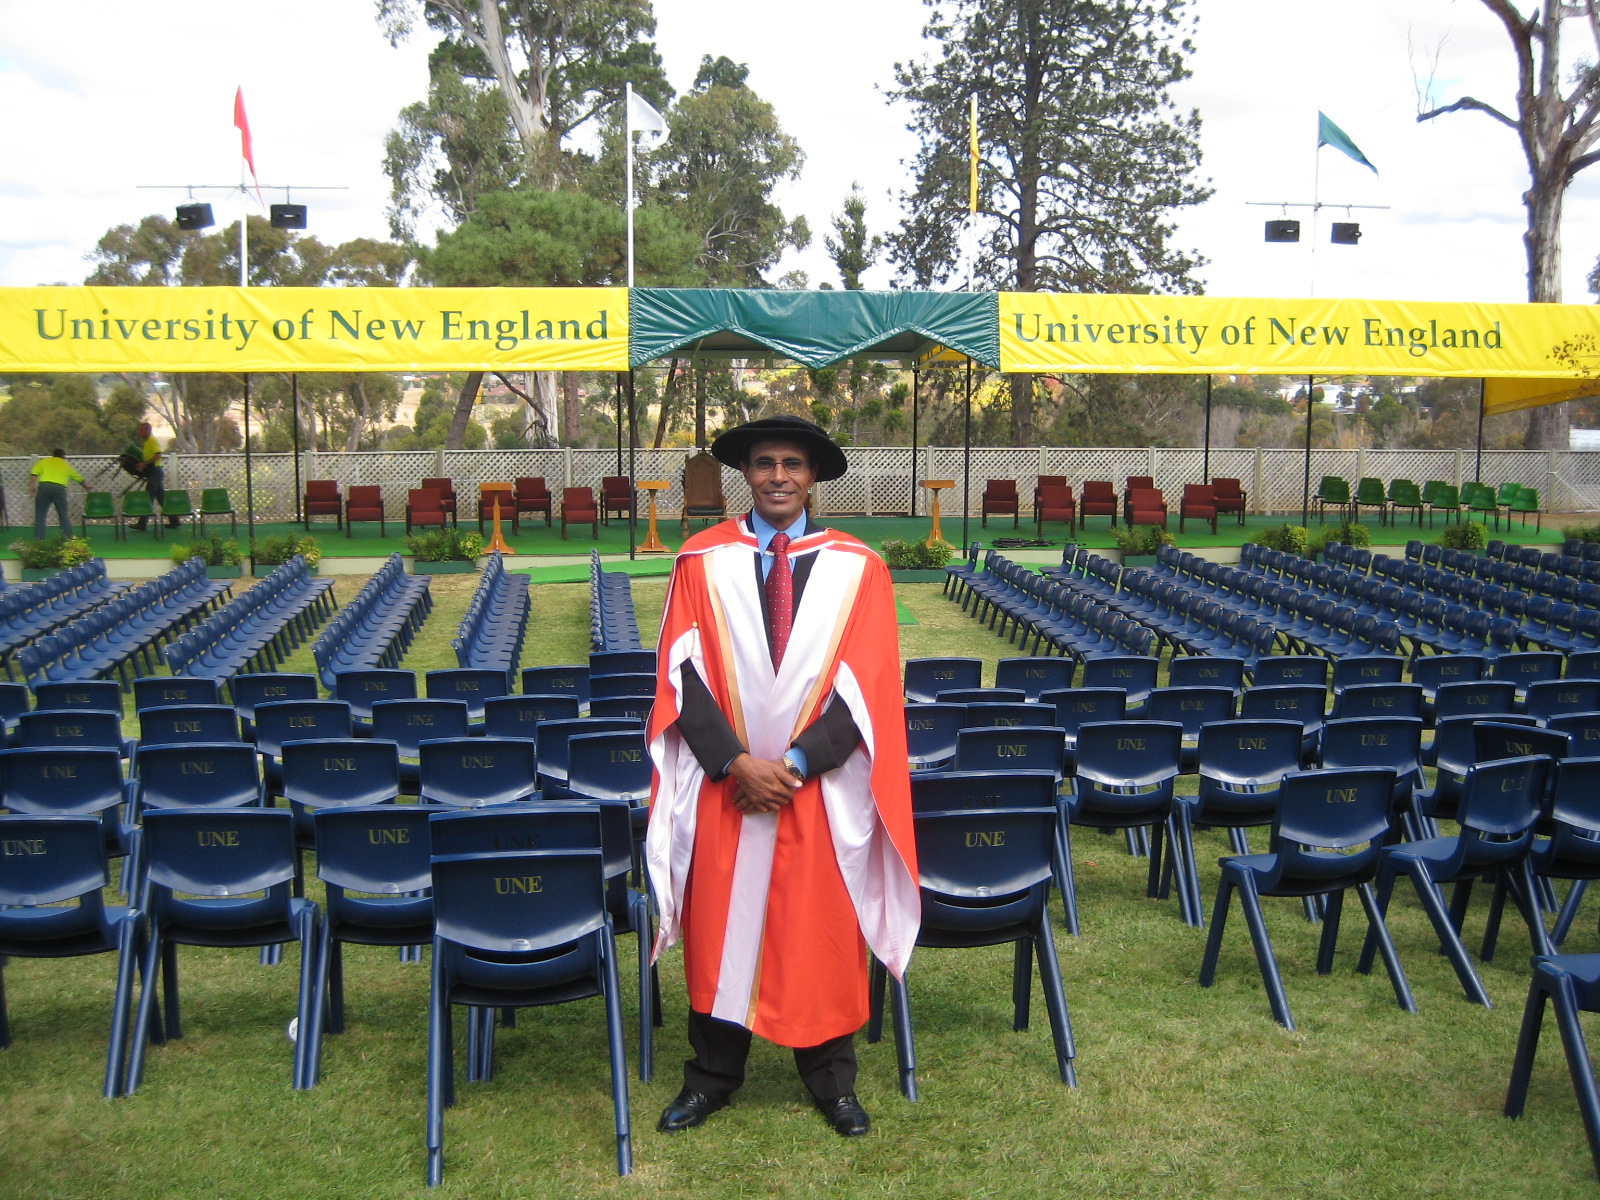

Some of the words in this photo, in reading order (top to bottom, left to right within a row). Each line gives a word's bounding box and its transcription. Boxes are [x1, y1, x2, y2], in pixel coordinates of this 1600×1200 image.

[34, 308, 259, 351] University
[272, 308, 314, 341] of
[329, 310, 425, 341] New
[440, 309, 608, 350] England
[1014, 312, 1209, 355] University
[1221, 315, 1256, 346] of
[1267, 317, 1350, 346] New
[1363, 318, 1503, 357] England
[1113, 669, 1132, 677] UNE
[1199, 669, 1219, 677] UNE
[1282, 668, 1302, 677] UNE
[1361, 668, 1380, 677] UNE
[1441, 666, 1459, 675] UNE
[1521, 663, 1539, 672] UNE
[933, 671, 954, 679] UNE
[1026, 670, 1046, 678] UNE
[455, 682, 479, 691] UNE
[552, 678, 574, 688] UNE
[164, 690, 187, 700] UNE
[264, 687, 286, 696] UNE
[1372, 697, 1394, 707] UNE
[1467, 695, 1488, 705] UNE
[1557, 693, 1578, 703] UNE
[1072, 702, 1095, 713] UNE
[1181, 700, 1204, 710] UNE
[1275, 699, 1297, 709] UNE
[408, 715, 433, 725] UNE
[519, 711, 545, 721] UNE
[174, 721, 201, 732] UNE
[289, 717, 316, 727] UNE
[908, 719, 933, 730] UNE
[55, 726, 83, 737] UNE
[1117, 739, 1145, 750] UNE
[1238, 738, 1266, 750] UNE
[1361, 734, 1387, 746] UNE
[997, 745, 1027, 757] UNE
[1506, 742, 1532, 754] UNE
[610, 750, 641, 762] UNE
[324, 758, 356, 770] UNE
[461, 756, 493, 768] UNE
[43, 766, 76, 778] UNE
[181, 762, 213, 774] UNE
[1326, 789, 1357, 803] UNE
[198, 831, 239, 846] UNE
[369, 829, 409, 844] UNE
[965, 831, 1004, 847] UNE
[3, 839, 47, 856] UNE
[495, 876, 543, 895] UNE
